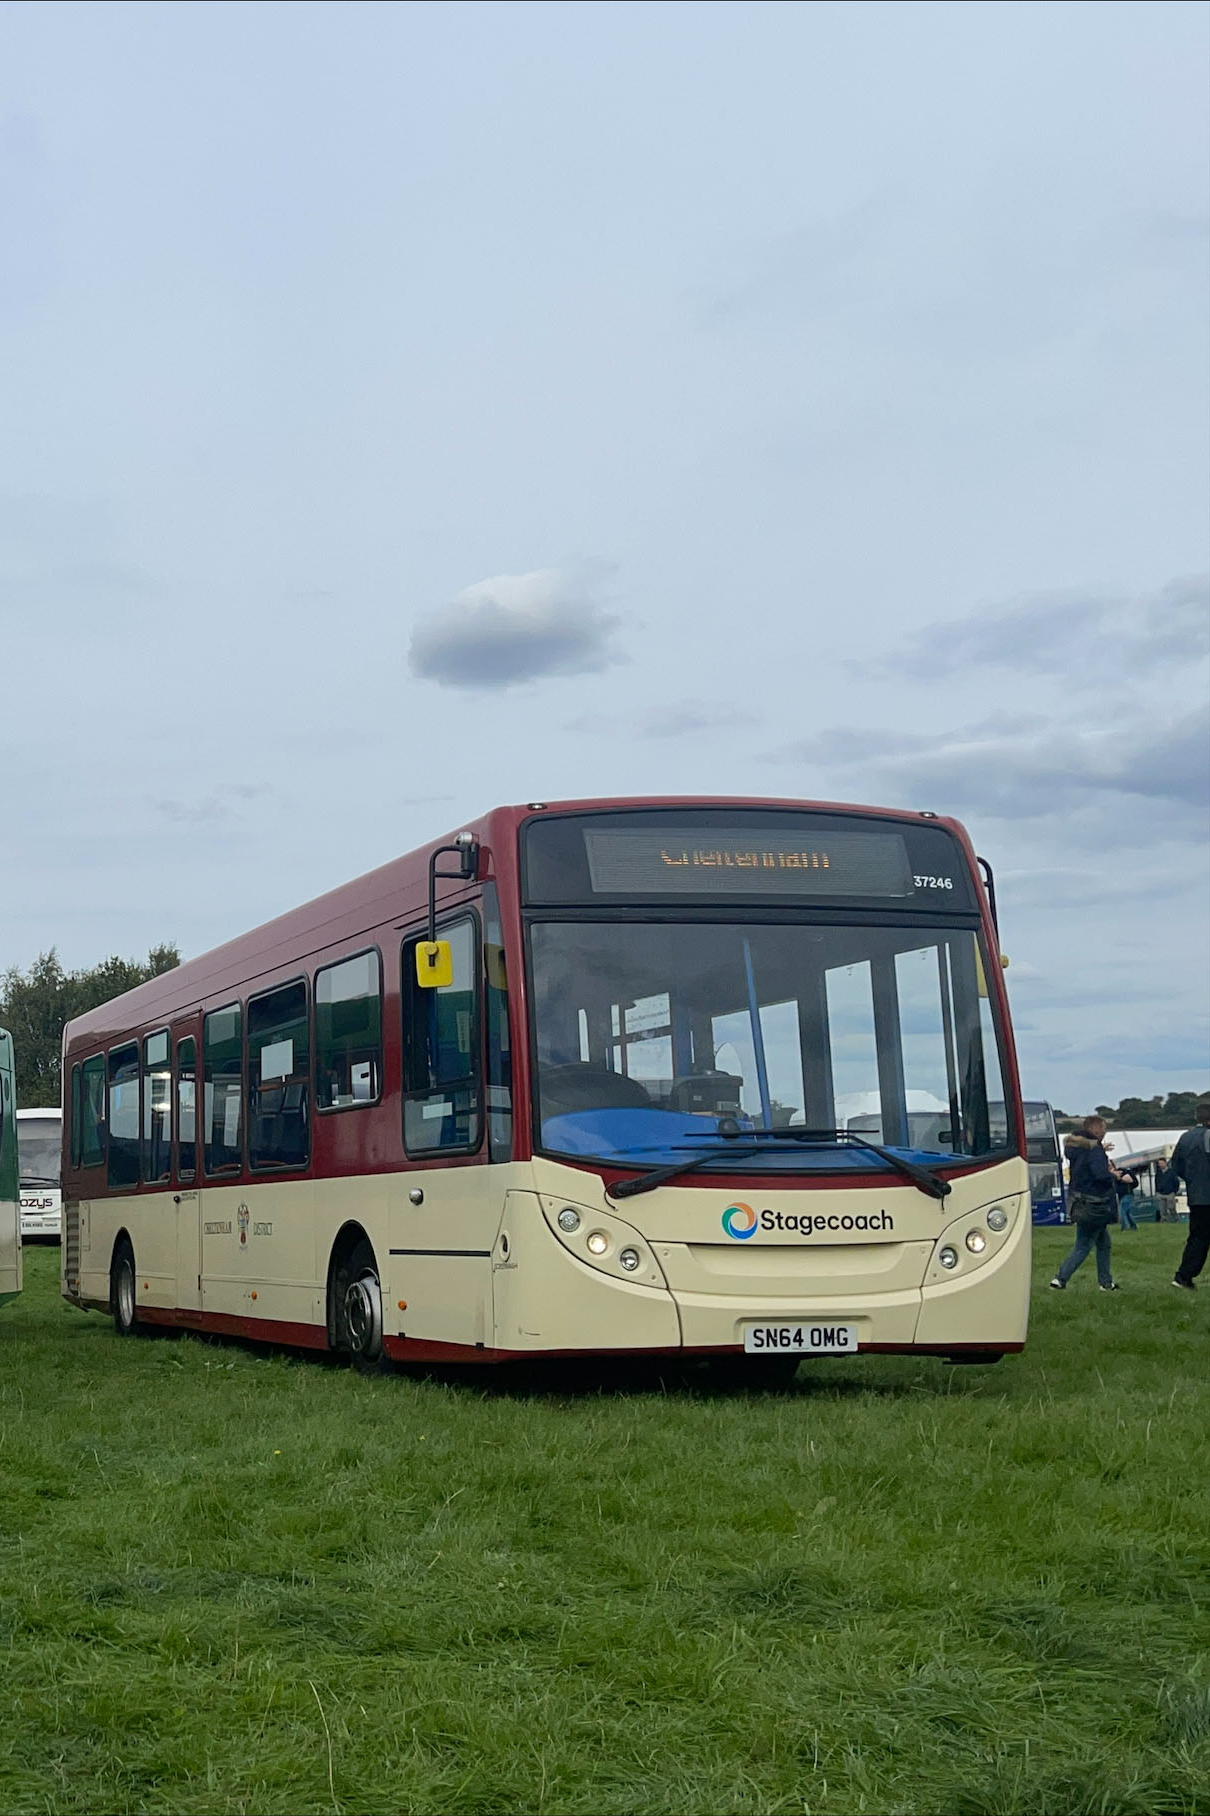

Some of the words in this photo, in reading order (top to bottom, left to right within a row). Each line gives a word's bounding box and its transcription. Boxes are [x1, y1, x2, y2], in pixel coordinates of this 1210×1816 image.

[913, 876, 953, 890] 37246
[761, 1209, 893, 1235] Stagecoach
[753, 1328, 804, 1347] SN64
[810, 1327, 848, 1346] OMG
